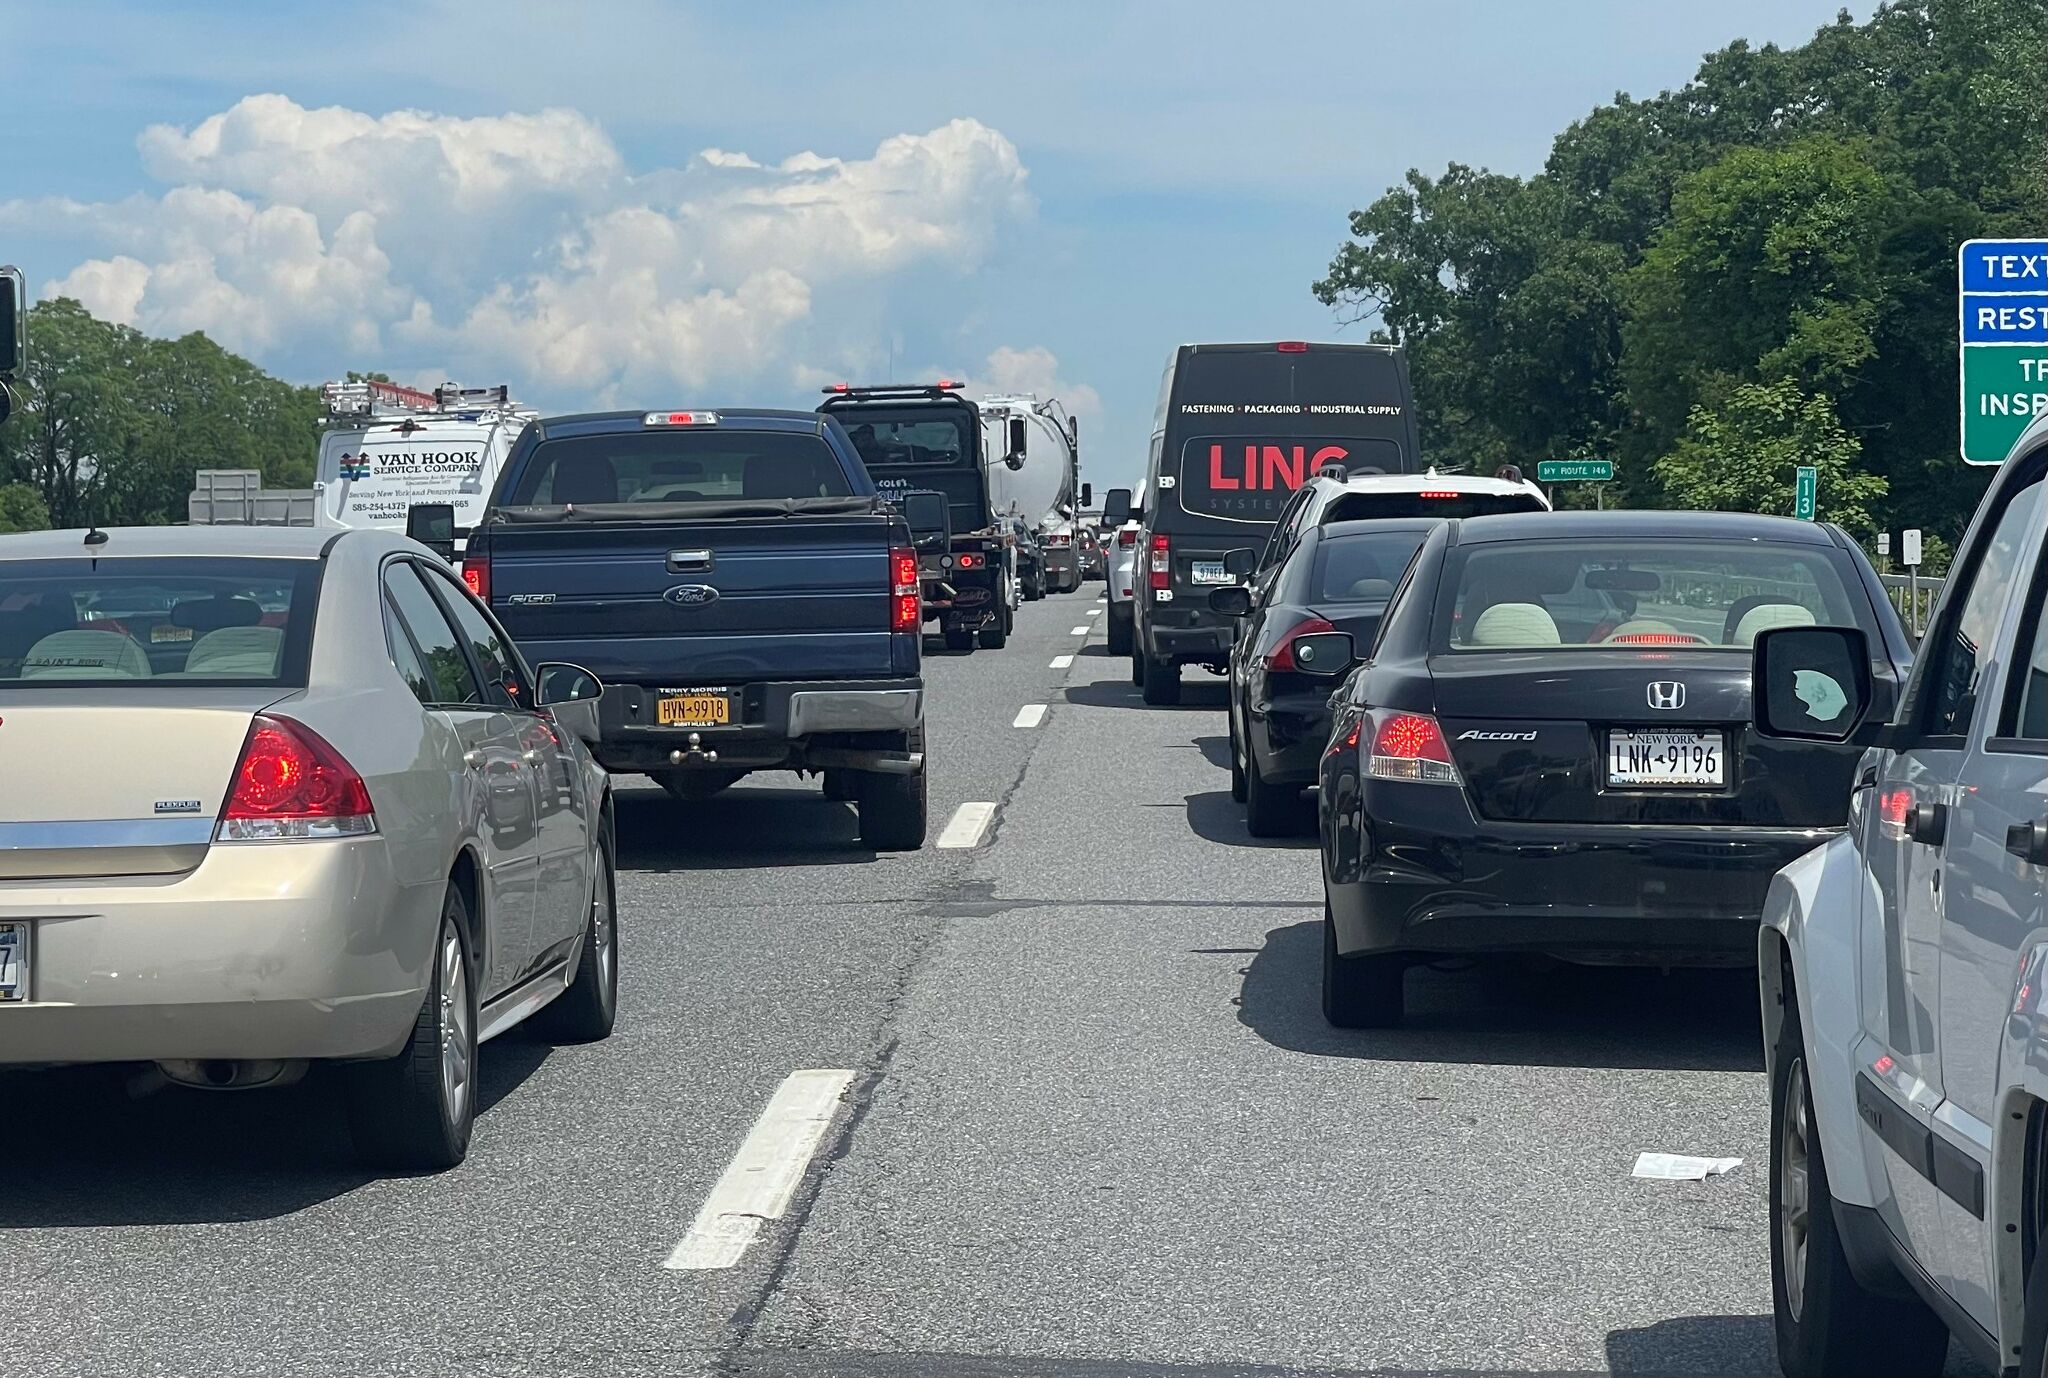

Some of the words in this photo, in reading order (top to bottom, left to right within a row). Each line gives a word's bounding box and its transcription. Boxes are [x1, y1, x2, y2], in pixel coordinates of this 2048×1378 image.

[1982, 255, 2048, 278] TEXT
[1978, 307, 2048, 330] REST
[2019, 359, 2048, 382] TR
[1181, 404, 1235, 414] FASTENING
[1244, 404, 1301, 414] PACKAGING
[1310, 405, 1366, 415] INDUSTRIAL
[1367, 406, 1402, 416] SUPPLY
[1981, 393, 2048, 416] INSP
[378, 453, 416, 466] VAN
[421, 452, 478, 464] HOOK
[373, 465, 421, 475] SERVICE
[424, 464, 481, 473] COMPANY
[1544, 467, 1556, 475] NY
[1560, 467, 1588, 475] ROUTE
[348, 490, 376, 499] Serving
[377, 489, 394, 498] New
[395, 489, 410, 497] York
[1210, 499, 1290, 511] SYSTEM
[368, 512, 408, 520] vanhooks
[676, 588, 707, 603] Ford
[1456, 729, 1538, 742] Accord
[1636, 735, 1662, 745] NEW
[1664, 735, 1696, 745] YORK
